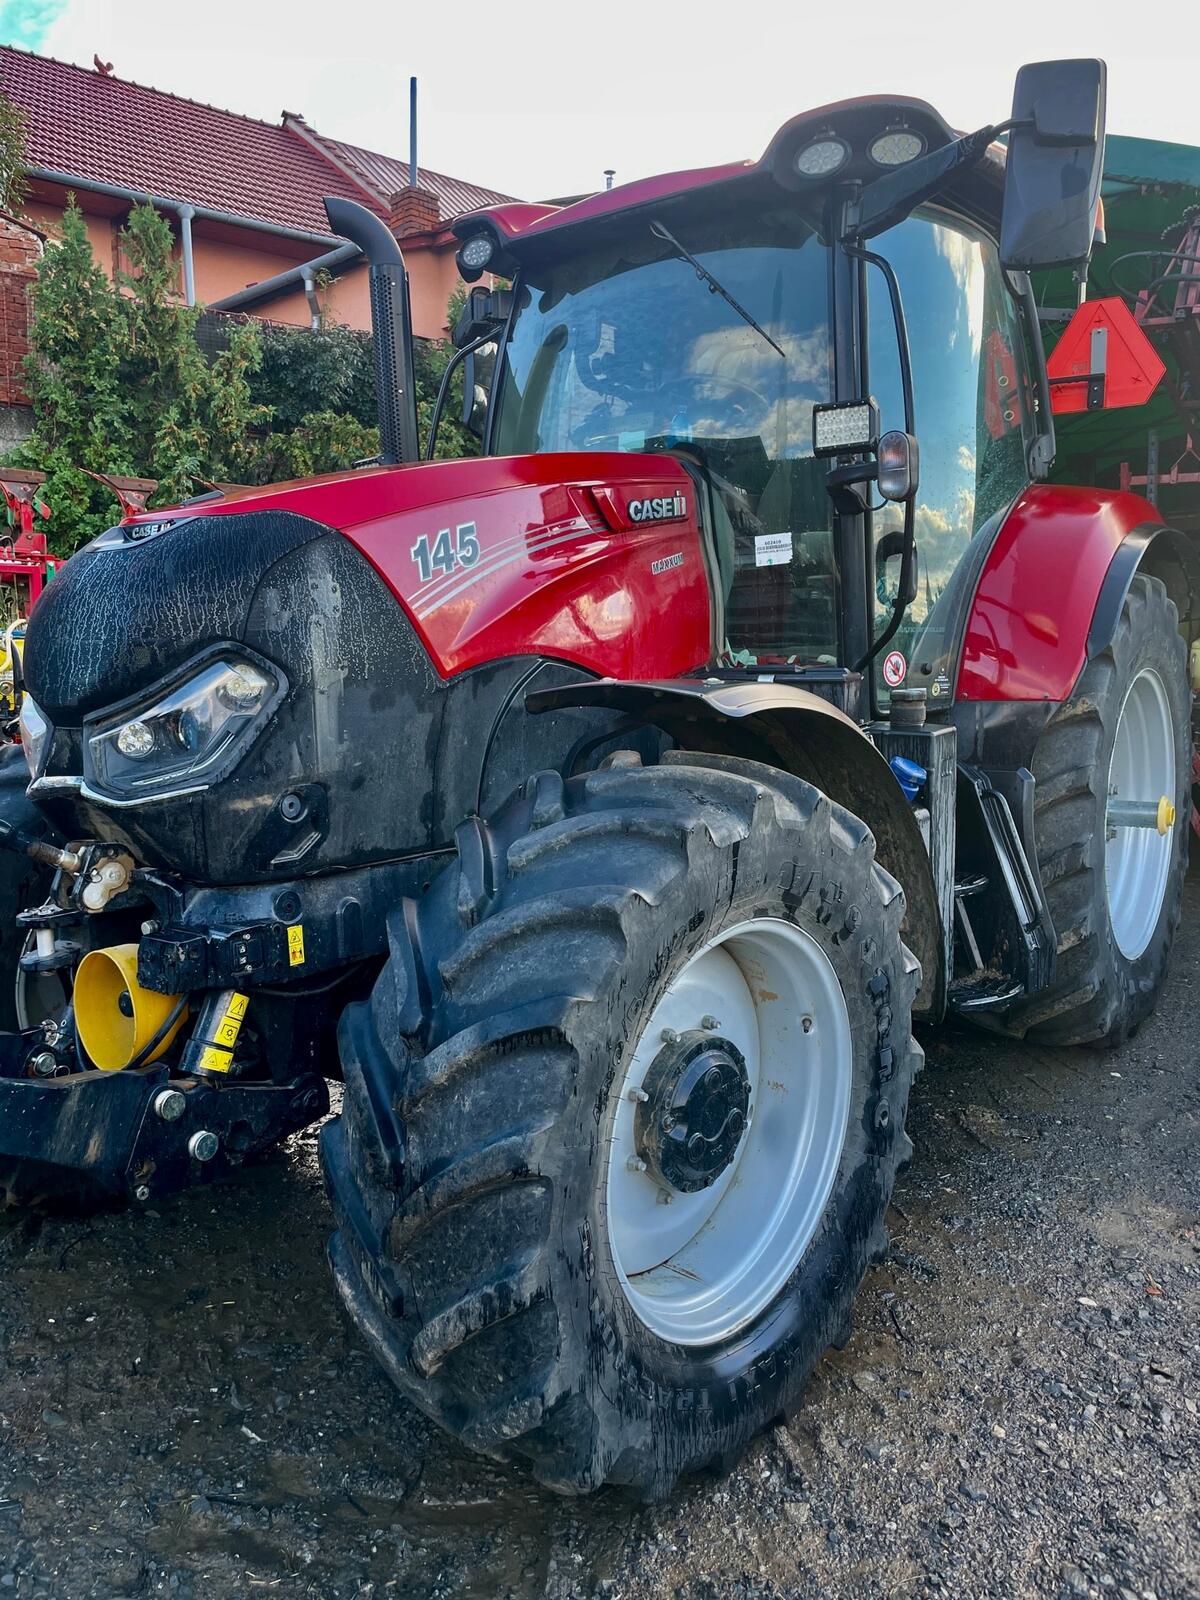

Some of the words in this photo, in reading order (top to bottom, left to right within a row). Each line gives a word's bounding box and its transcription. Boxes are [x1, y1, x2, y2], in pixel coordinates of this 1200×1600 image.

[629, 498, 673, 521] CASE
[410, 520, 481, 582] 145
[651, 551, 684, 575] MAXXUM
